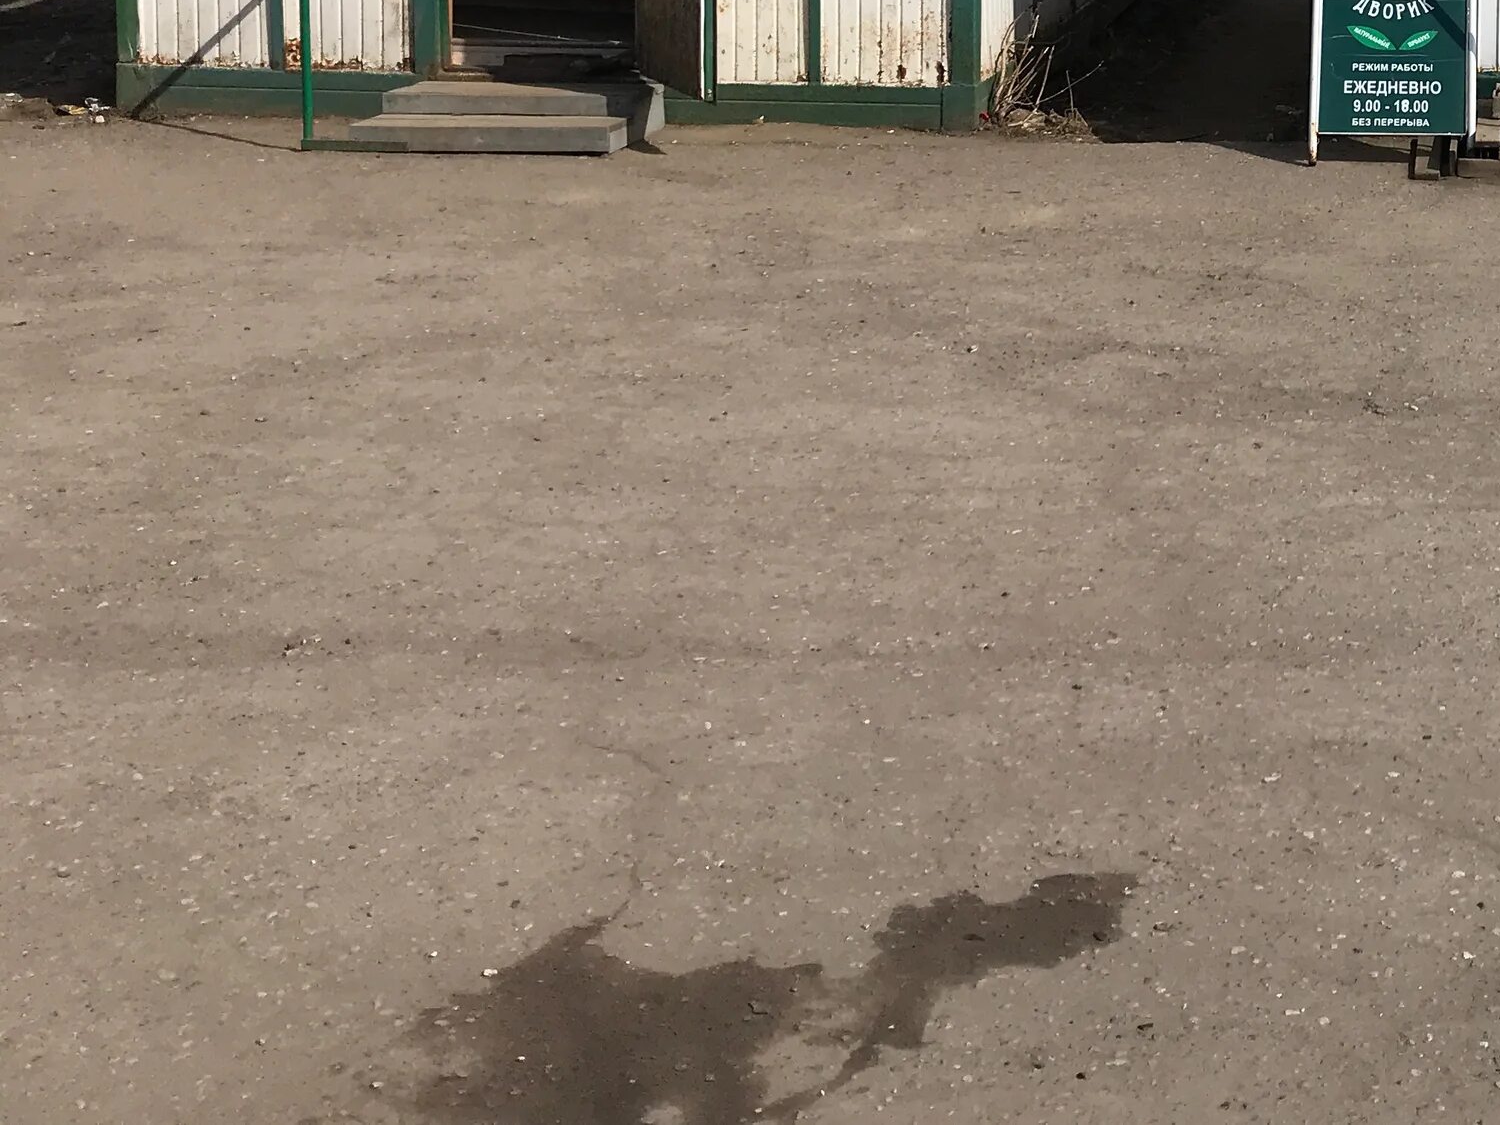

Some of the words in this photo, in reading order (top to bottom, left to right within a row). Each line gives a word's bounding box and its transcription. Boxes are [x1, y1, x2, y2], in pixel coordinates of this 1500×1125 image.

[1352, 63, 1389, 71] РЕЖИМ
[1391, 63, 1434, 72] РАБОТЫ
[1343, 80, 1442, 97] ЕЖЕДНЕВНО
[1353, 99, 1381, 113] 9.00
[1393, 98, 1429, 113] 18.00
[1351, 118, 1371, 127] БЕЗ
[1374, 118, 1430, 127] ПЕРЕРЫВА
